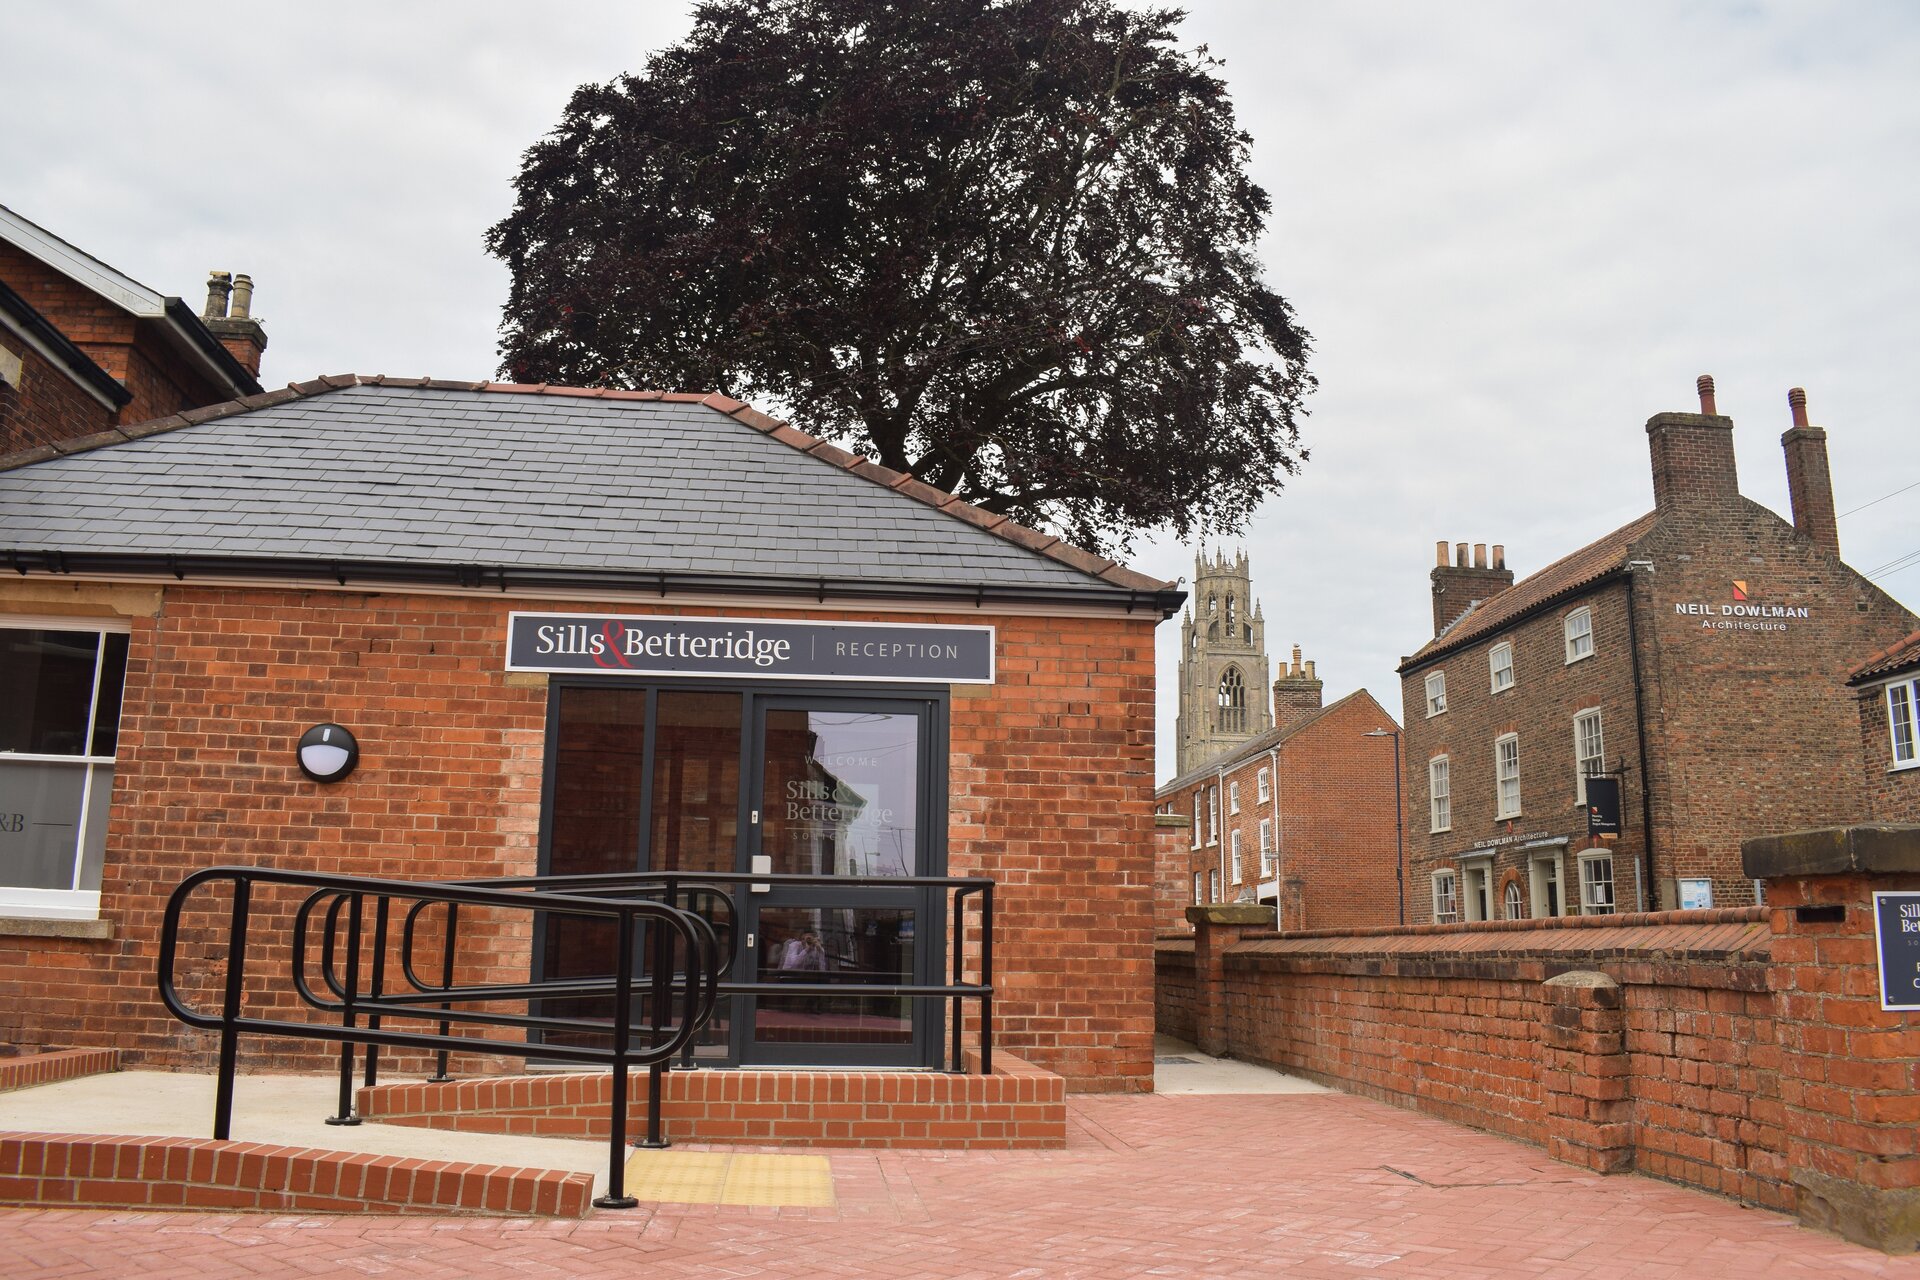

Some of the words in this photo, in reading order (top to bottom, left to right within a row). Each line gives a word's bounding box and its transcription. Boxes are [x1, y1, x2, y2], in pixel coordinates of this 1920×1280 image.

[1675, 603, 1715, 615] NEIL
[1722, 605, 1809, 618] DOWLMAN
[1702, 620, 1787, 631] Architecture
[836, 642, 958, 659] RECEPTION
[804, 754, 878, 767] WELCOME
